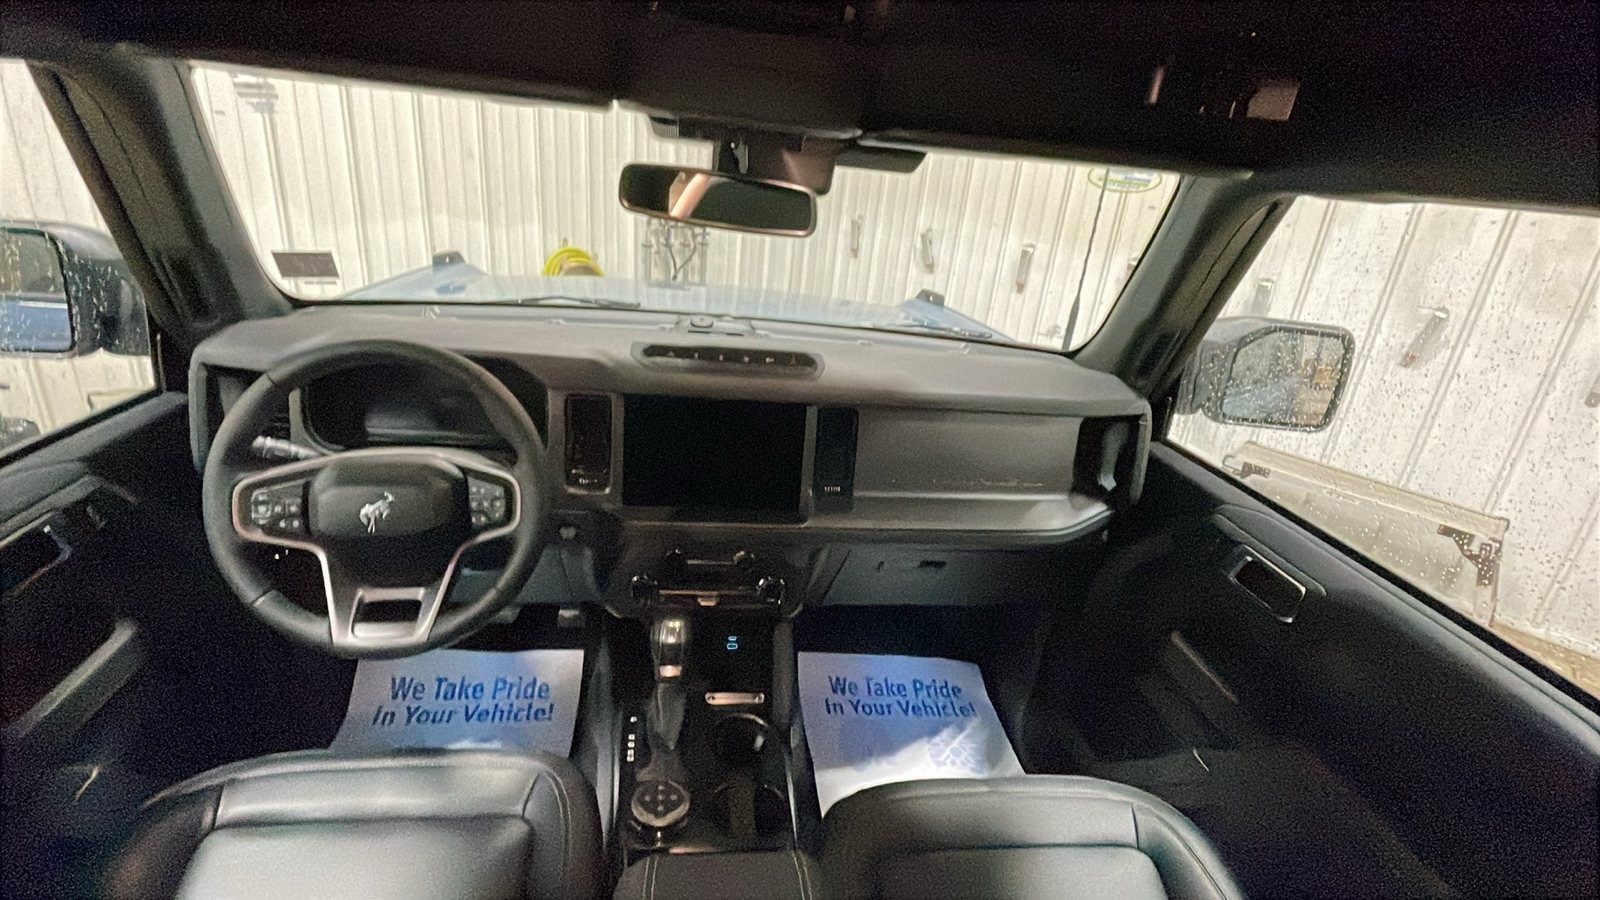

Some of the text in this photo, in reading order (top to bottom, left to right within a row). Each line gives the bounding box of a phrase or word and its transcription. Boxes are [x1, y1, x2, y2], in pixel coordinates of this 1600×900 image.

[391, 676, 551, 701] We Take Pride
[828, 675, 962, 700] We Take Pride
[404, 704, 458, 726] Your
[464, 702, 555, 723] Vehicle!
[848, 698, 893, 716] Your
[899, 700, 978, 718] Vehicle!
